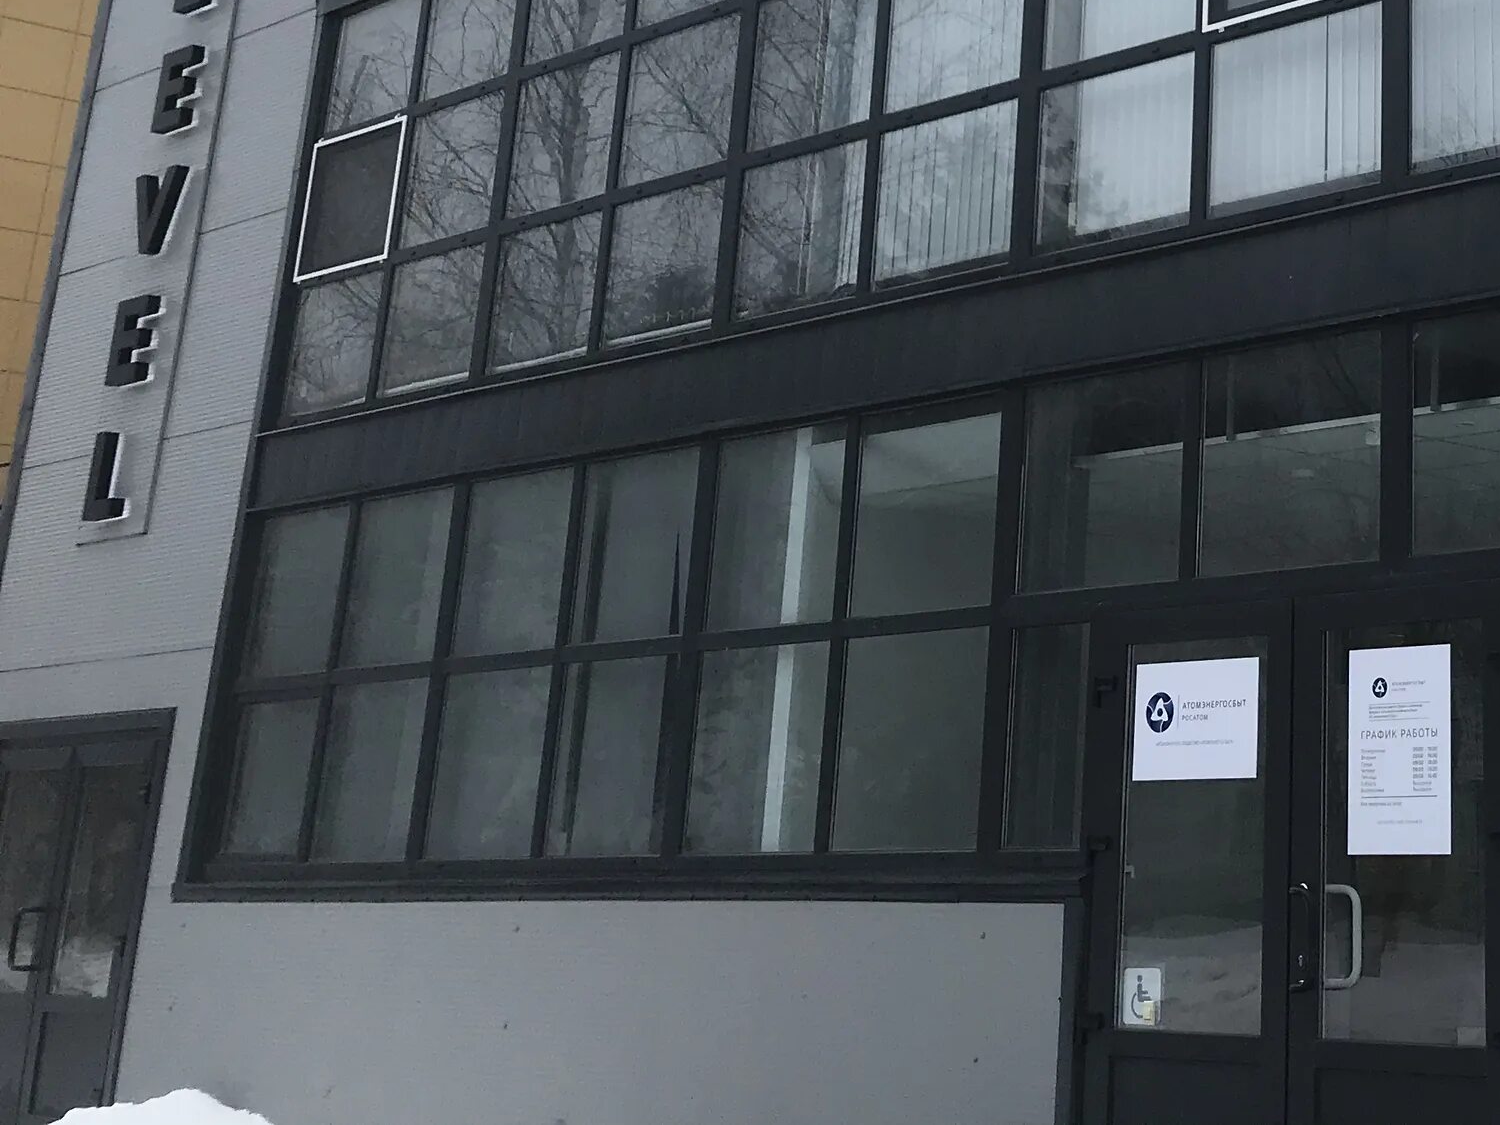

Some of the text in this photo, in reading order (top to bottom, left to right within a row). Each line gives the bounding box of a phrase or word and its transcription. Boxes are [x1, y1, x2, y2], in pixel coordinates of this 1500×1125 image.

[1182, 699, 1246, 710] АТОМЭНЕРГОСБЫТ
[1181, 714, 1208, 722] РОСАТОМ
[1360, 727, 1438, 740] ГРАФИК РАБОТЫ
